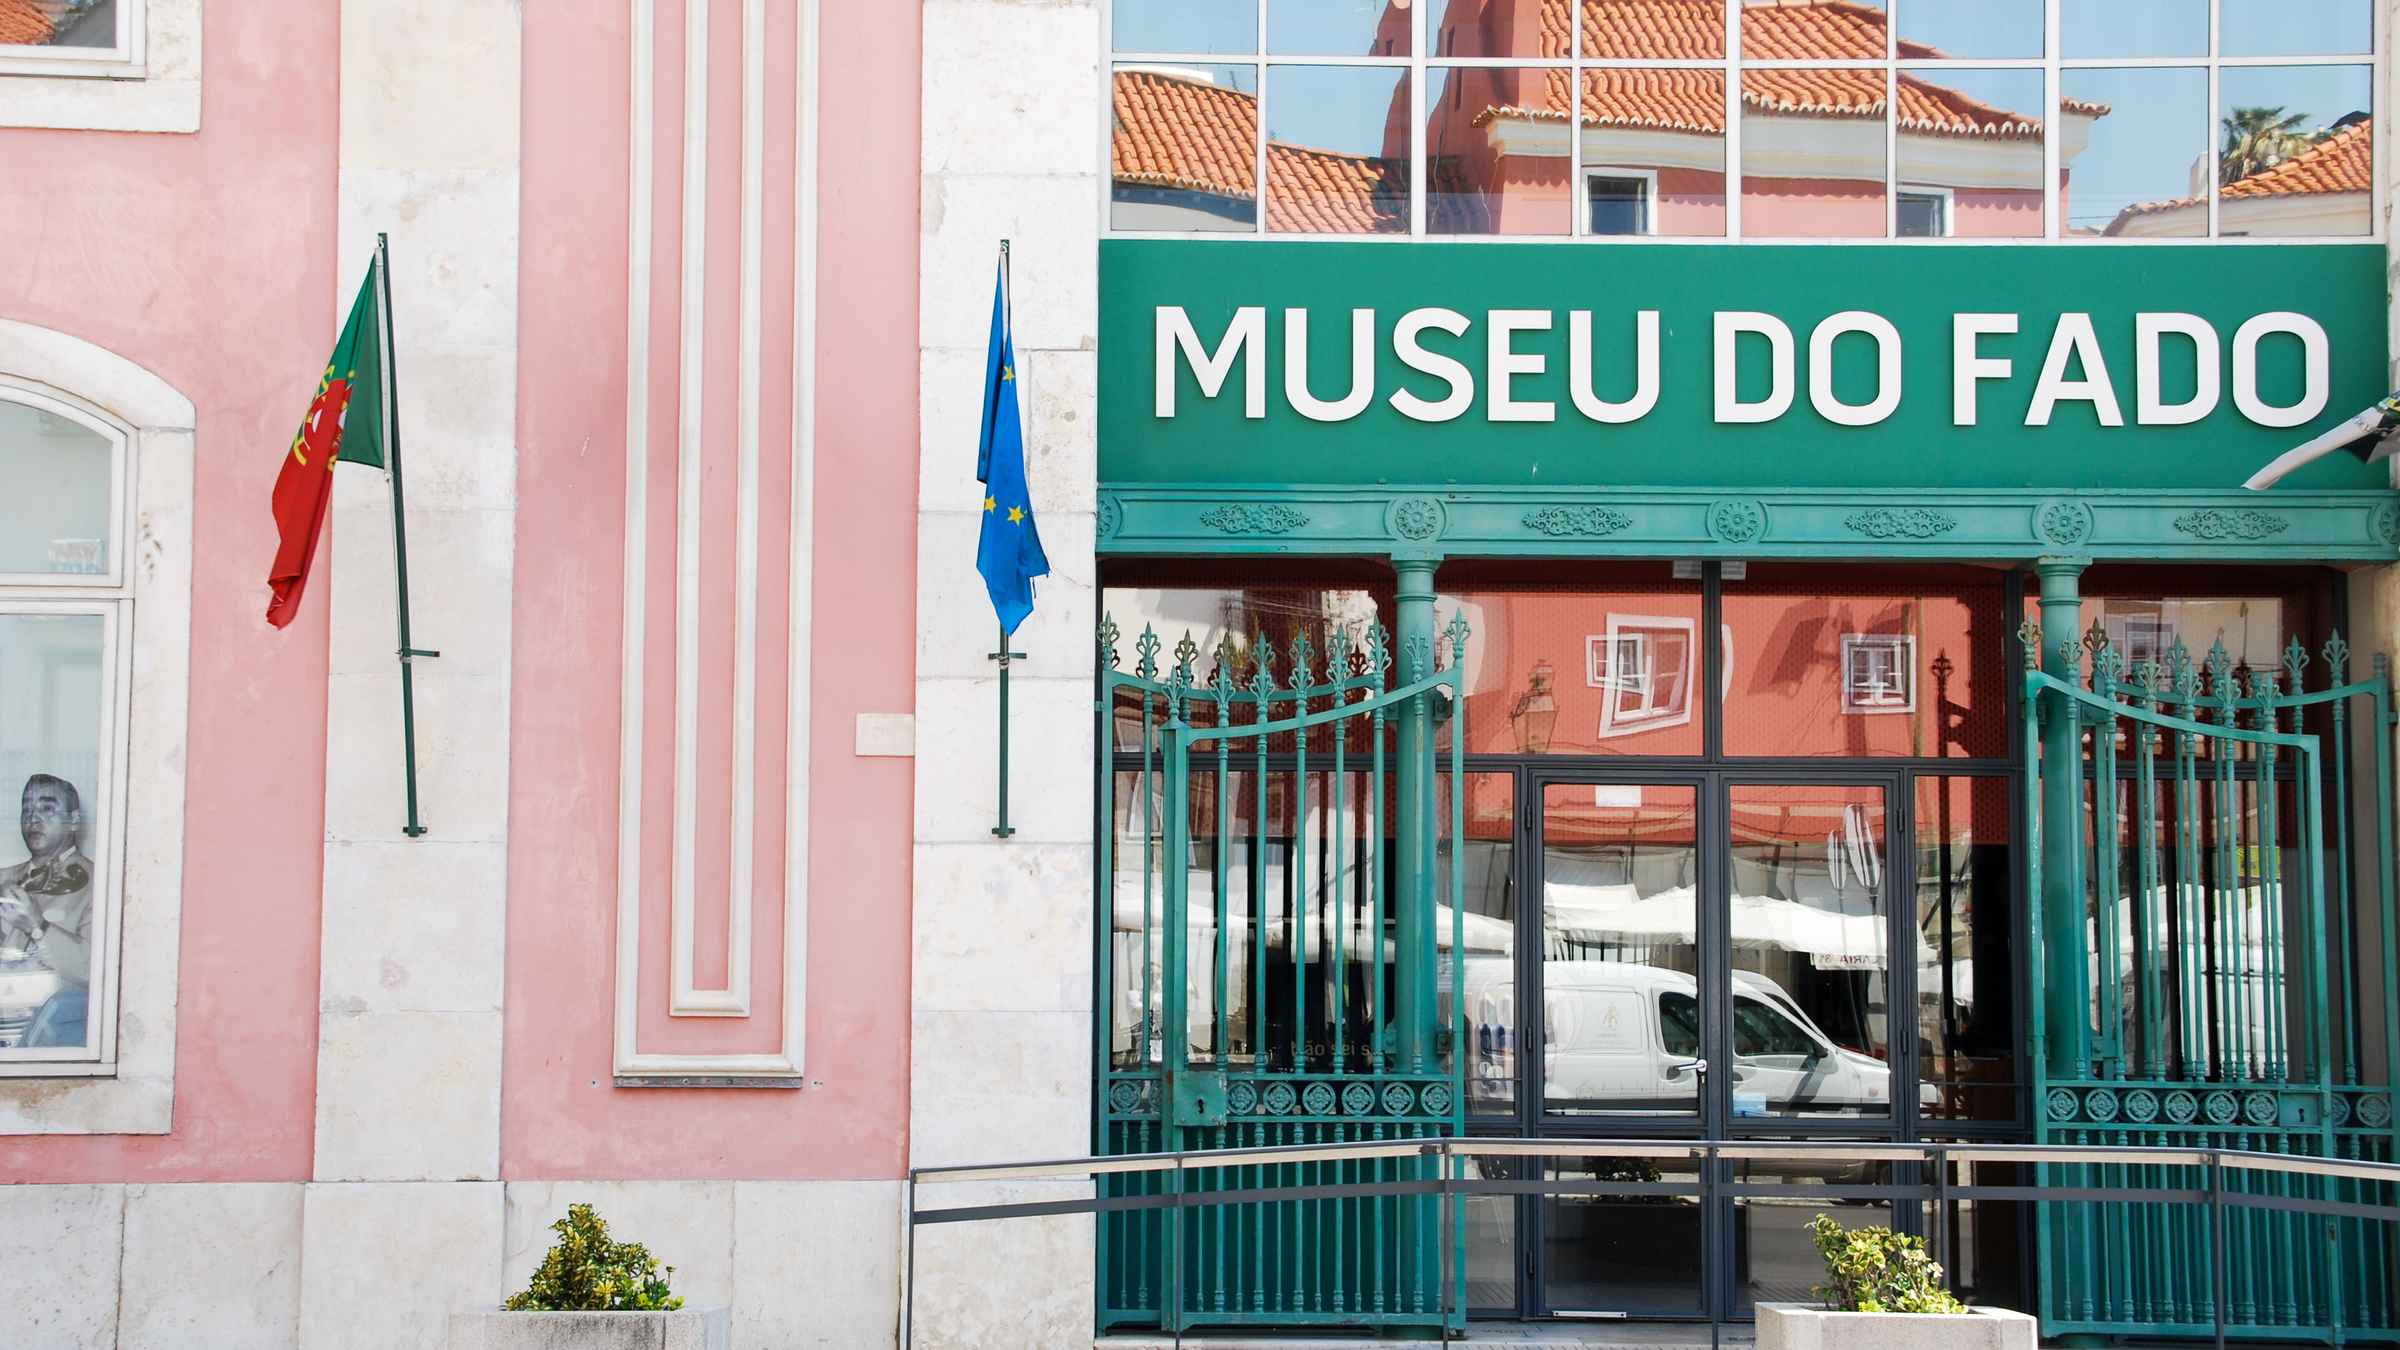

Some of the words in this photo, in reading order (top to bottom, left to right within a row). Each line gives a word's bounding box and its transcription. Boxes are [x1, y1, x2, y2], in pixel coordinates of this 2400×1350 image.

[1155, 306, 1660, 424] MUSEU
[1713, 310, 1902, 426] DO
[1953, 312, 2330, 428] FADO
